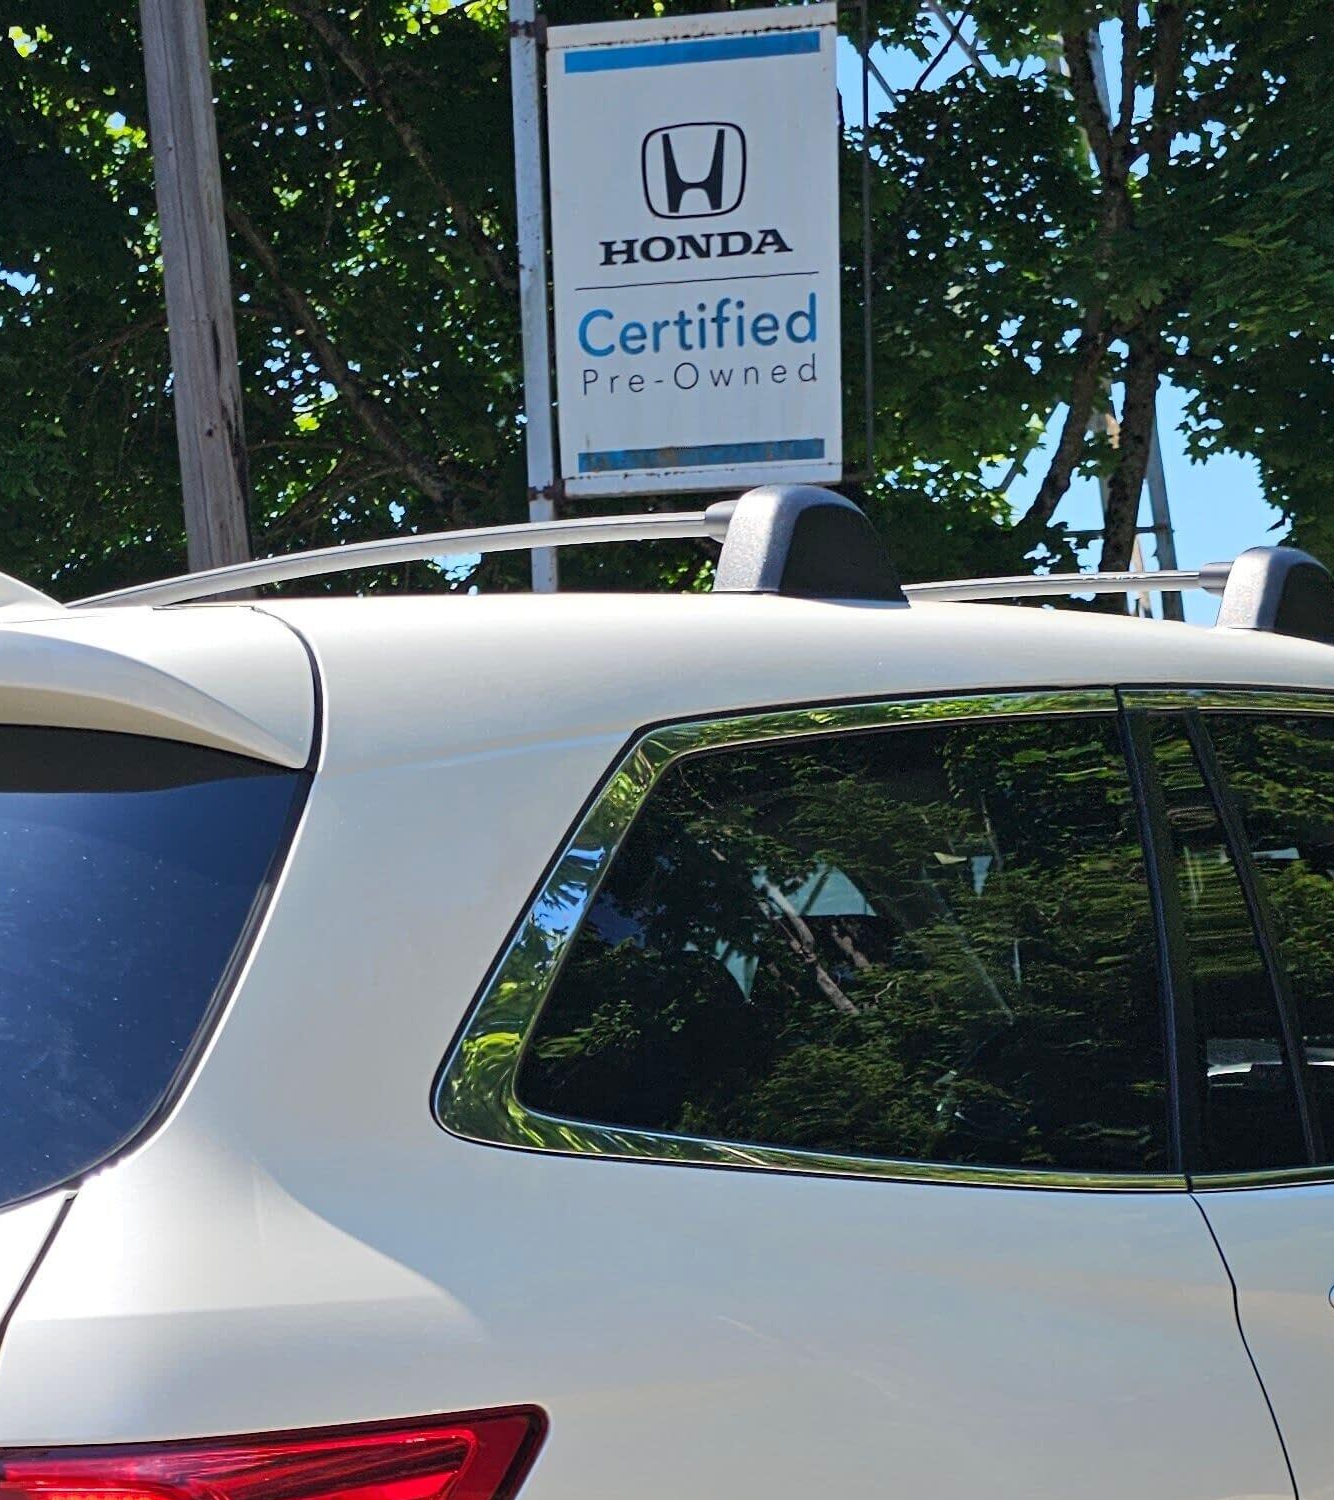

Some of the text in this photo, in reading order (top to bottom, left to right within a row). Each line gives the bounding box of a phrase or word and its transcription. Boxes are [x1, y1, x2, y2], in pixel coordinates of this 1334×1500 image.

[599, 228, 793, 267] HONDA
[577, 292, 818, 358] Certified
[582, 353, 818, 396] Pre-Owned
